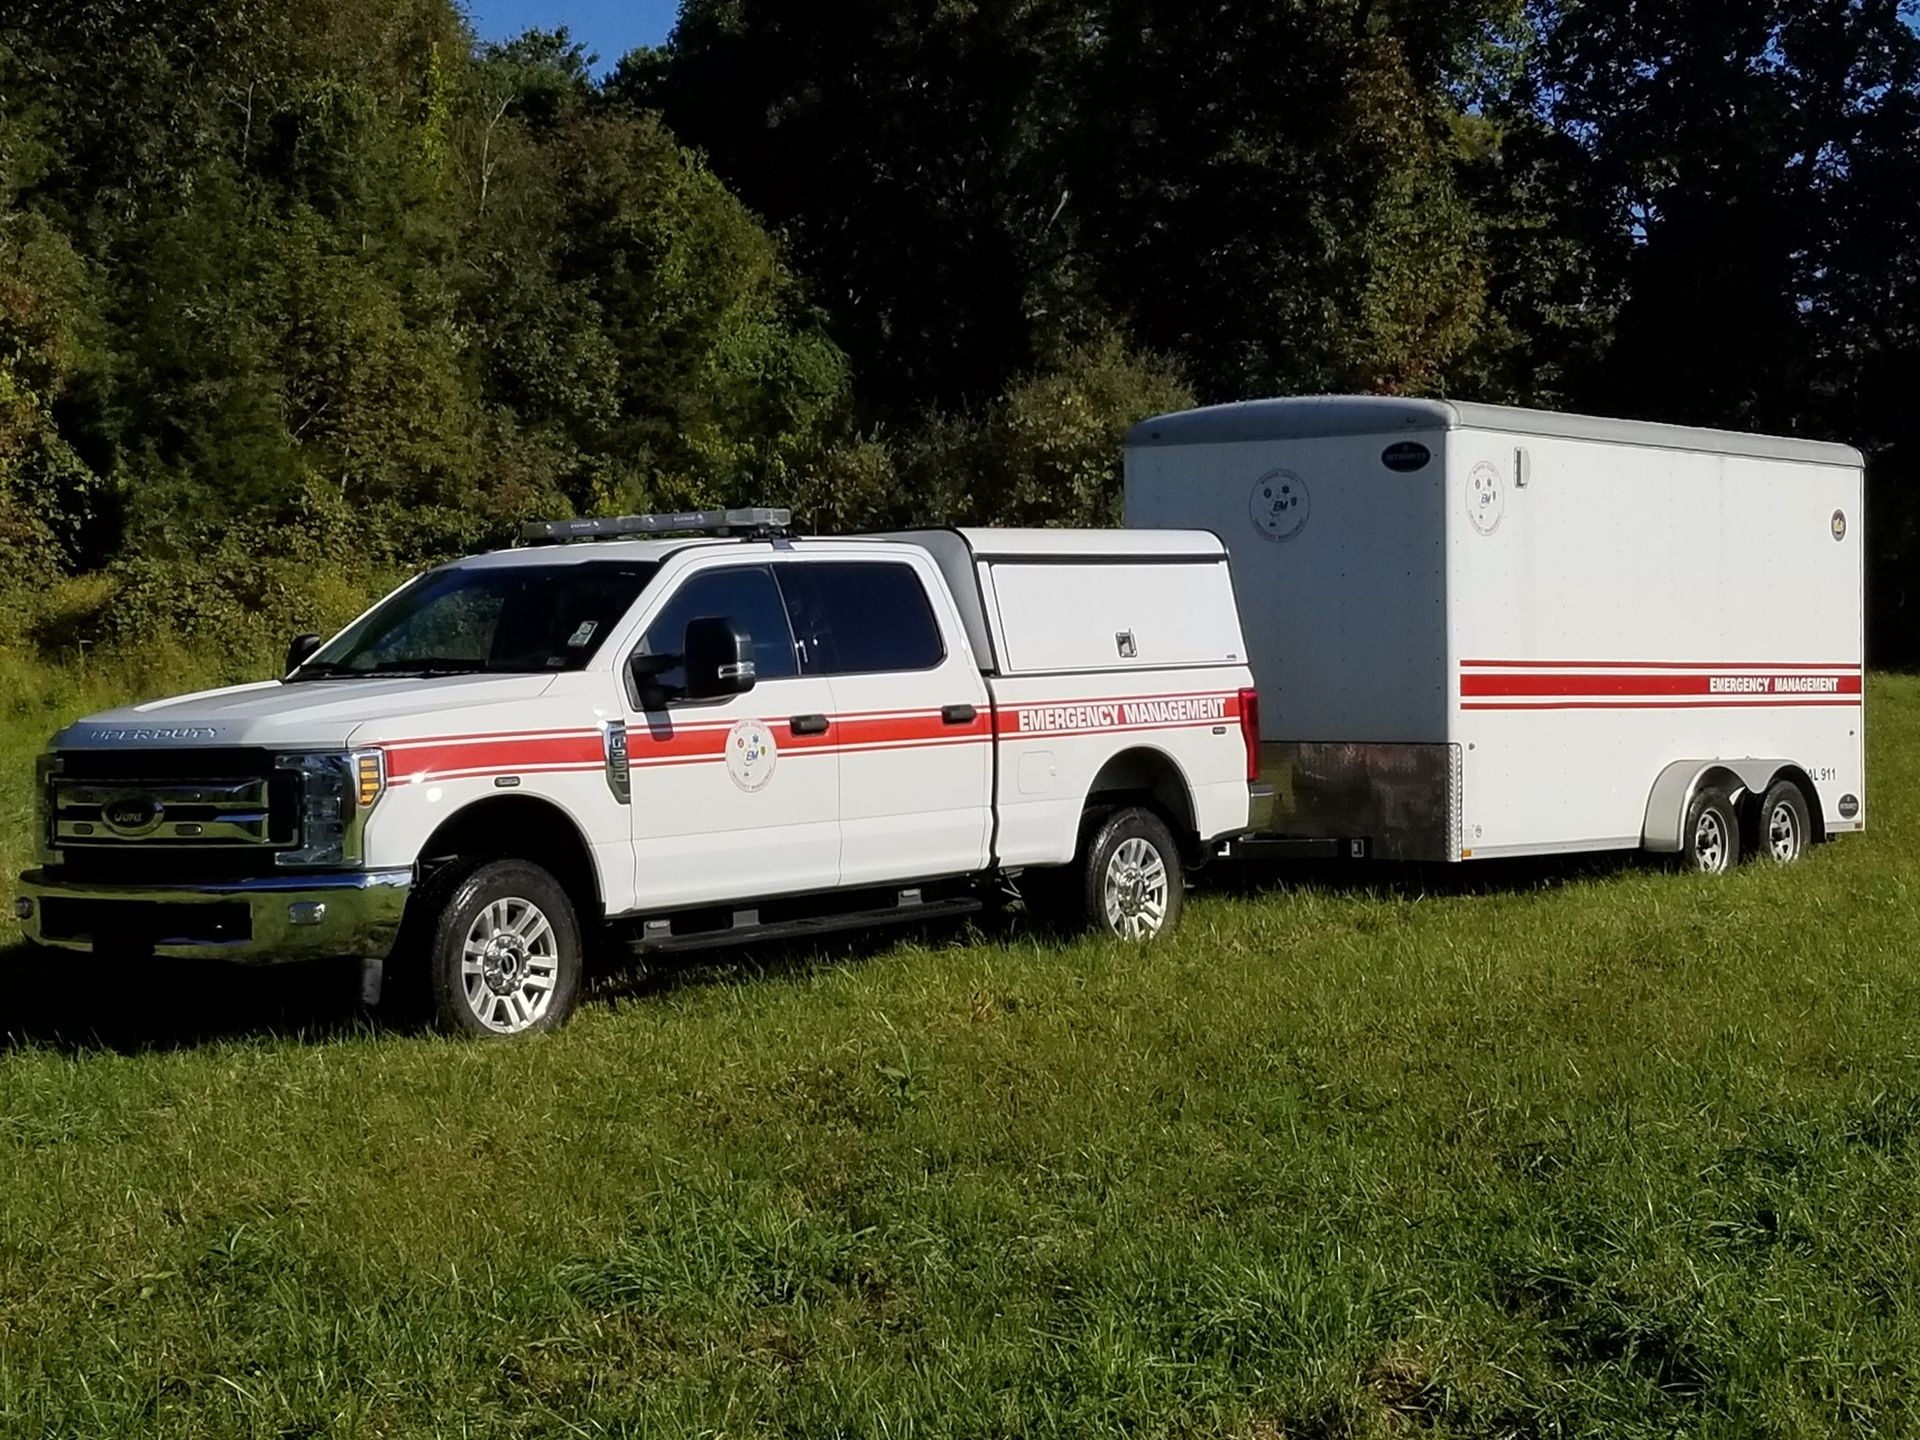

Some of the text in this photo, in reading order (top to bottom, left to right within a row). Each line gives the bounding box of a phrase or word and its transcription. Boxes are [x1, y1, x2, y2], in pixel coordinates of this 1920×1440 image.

[1710, 677, 1839, 693] EMERGENCY MANAGEMENT
[1018, 697, 1226, 732] EMERGENCY MANAGEMENT
[1820, 767, 1836, 781] 911
